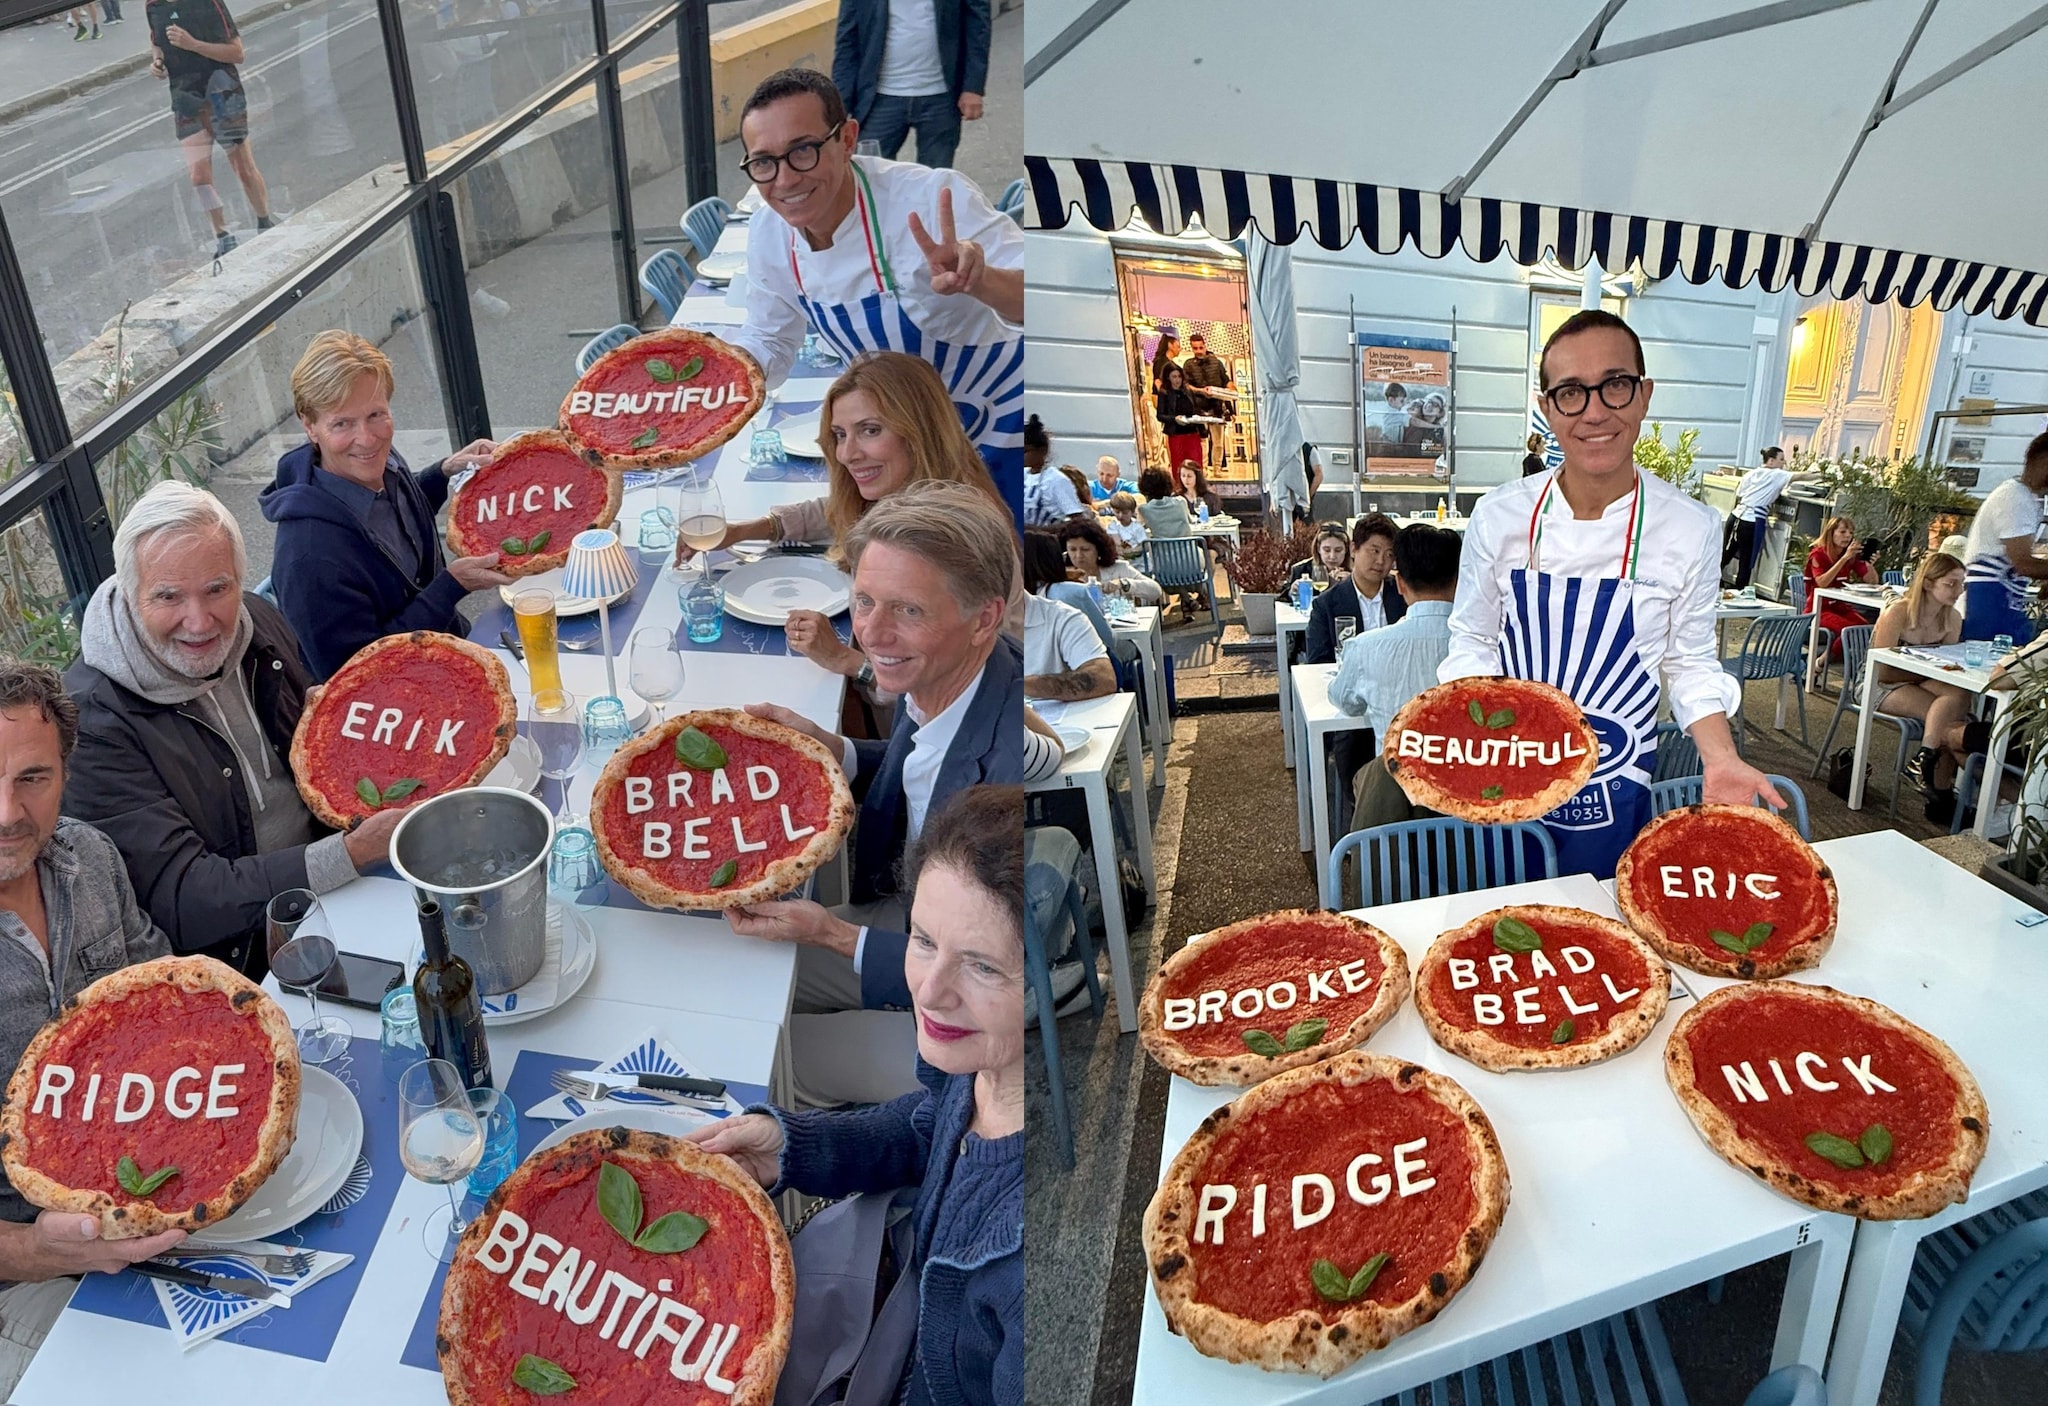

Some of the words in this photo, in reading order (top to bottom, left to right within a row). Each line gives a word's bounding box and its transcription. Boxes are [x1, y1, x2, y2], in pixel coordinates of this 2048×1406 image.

[1379, 359, 1405, 368] bisogno
[1380, 351, 1409, 361] bambino
[476, 483, 574, 523] NICK
[340, 701, 465, 757] ERIK
[625, 765, 780, 814] BRAD
[1563, 806, 1603, 821] 1935
[643, 803, 816, 860] BELL
[1660, 865, 1781, 900] ERIC
[1448, 946, 1595, 991] BRAD
[1163, 958, 1372, 1031] BROOKE
[1473, 972, 1641, 1025] BELL
[31, 1063, 246, 1124] RIDGE
[1721, 1051, 1897, 1103] NICK
[1193, 1137, 1437, 1245] RIDGE
